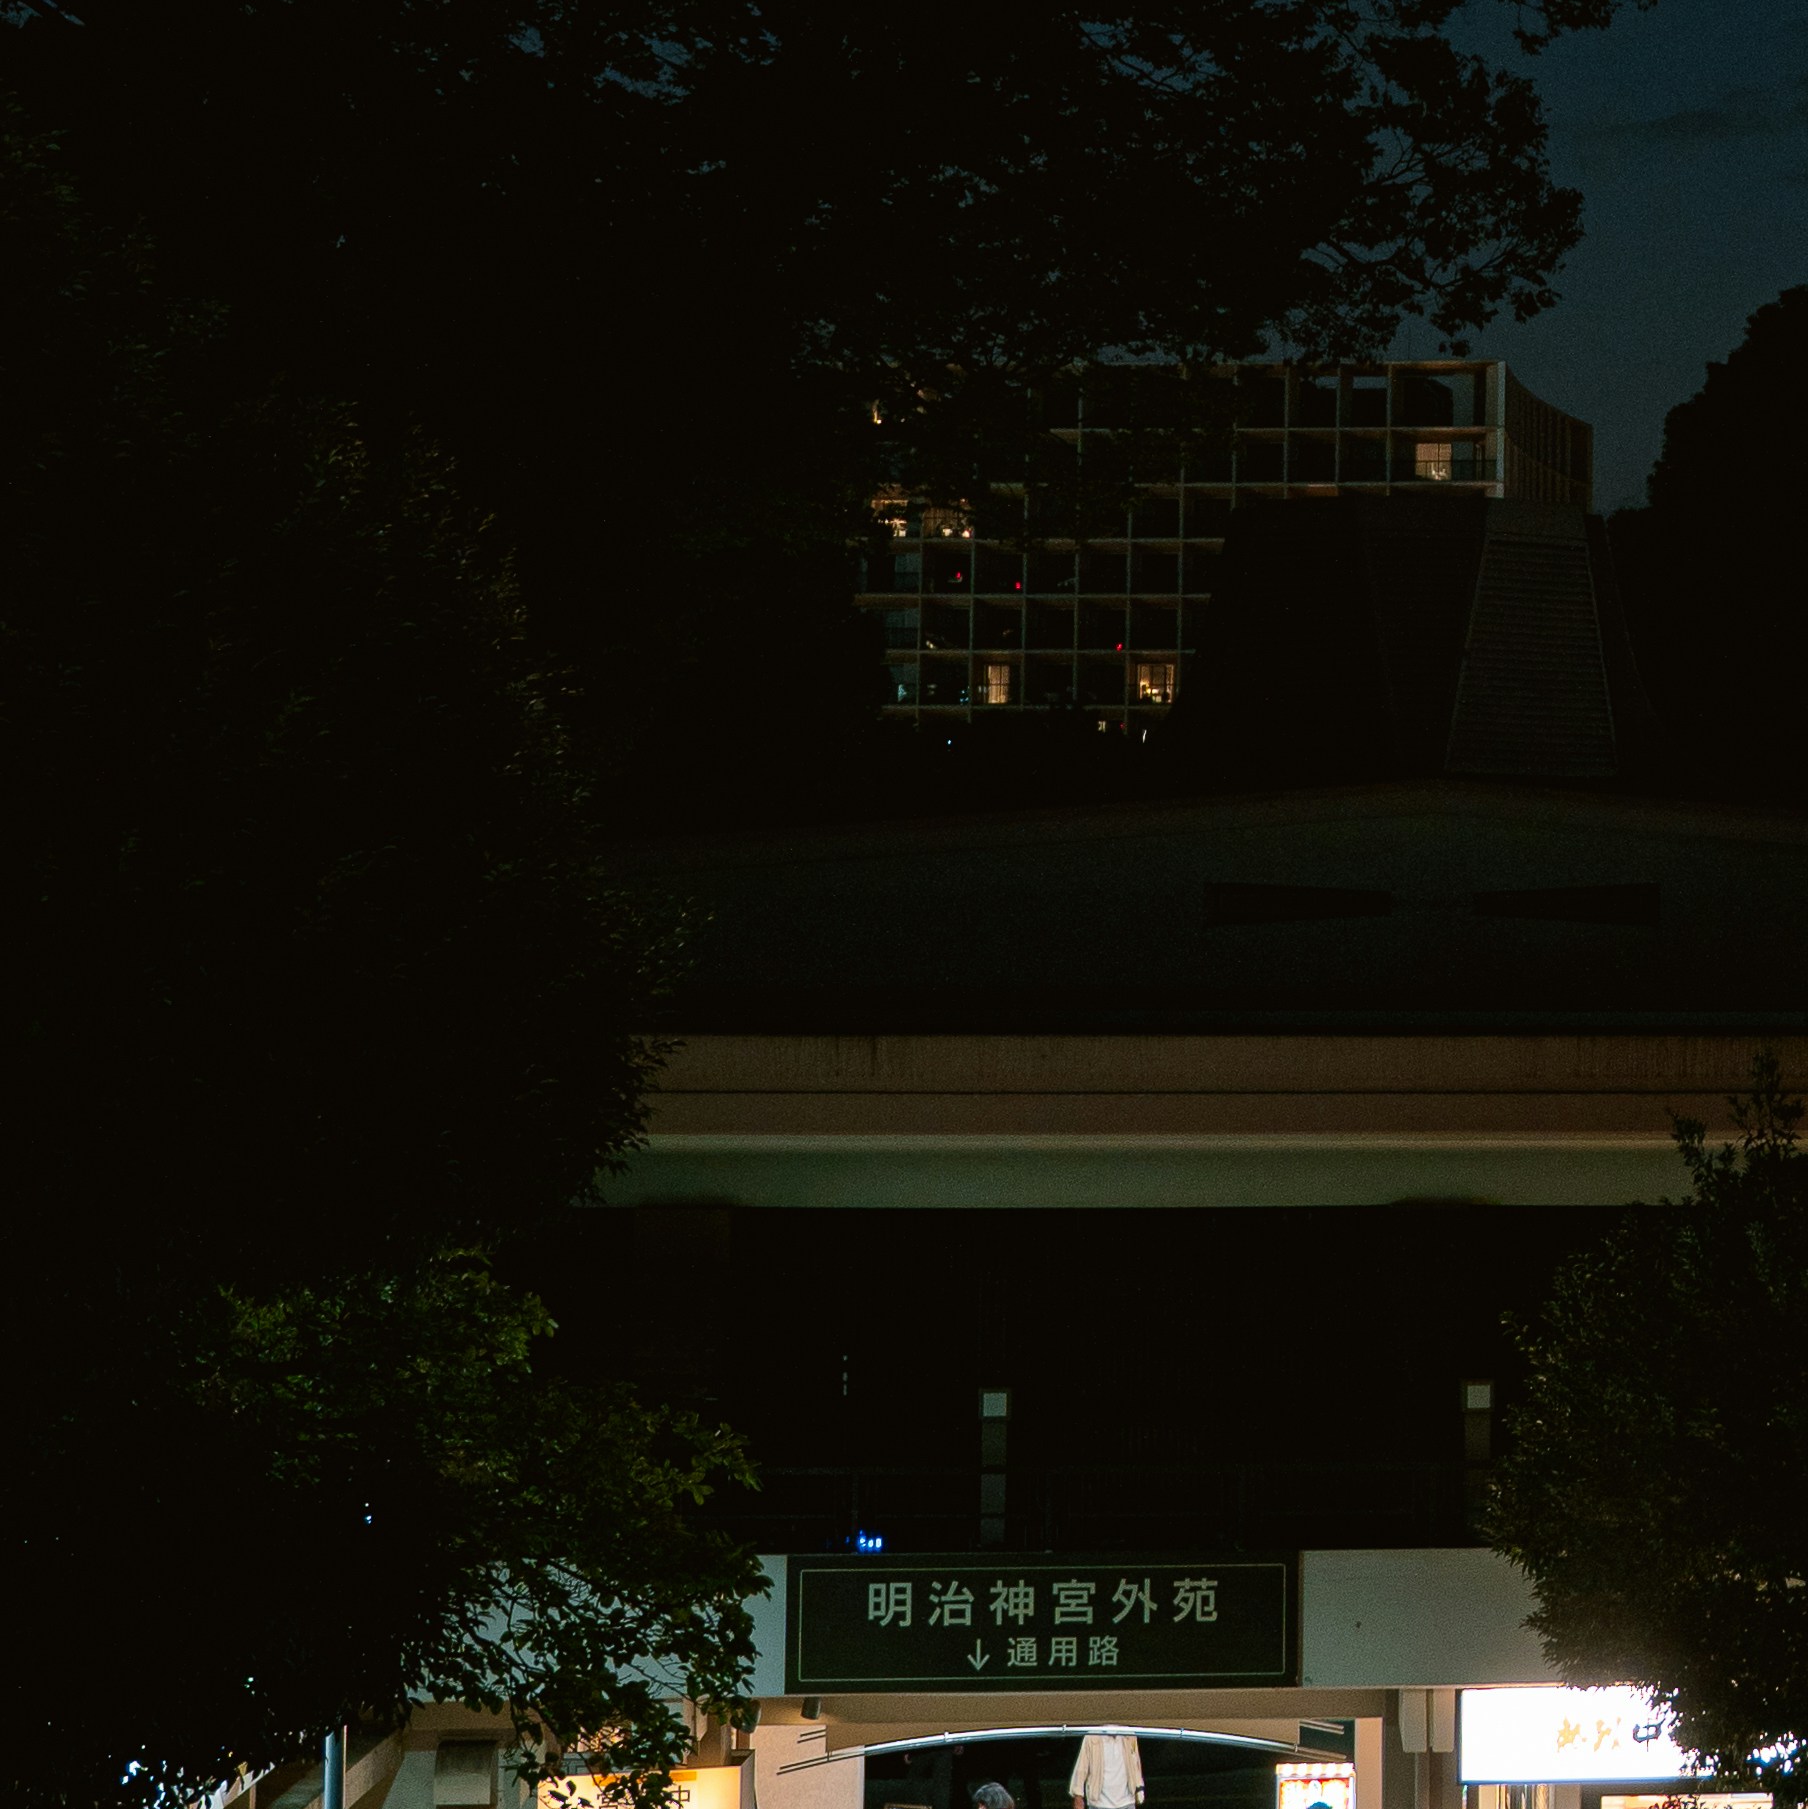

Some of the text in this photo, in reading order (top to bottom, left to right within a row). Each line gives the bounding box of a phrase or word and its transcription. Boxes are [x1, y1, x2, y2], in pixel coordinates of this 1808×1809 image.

[868, 1578, 1218, 1627] 明治神宮外苑
[1007, 1636, 1120, 1668] 通用路
